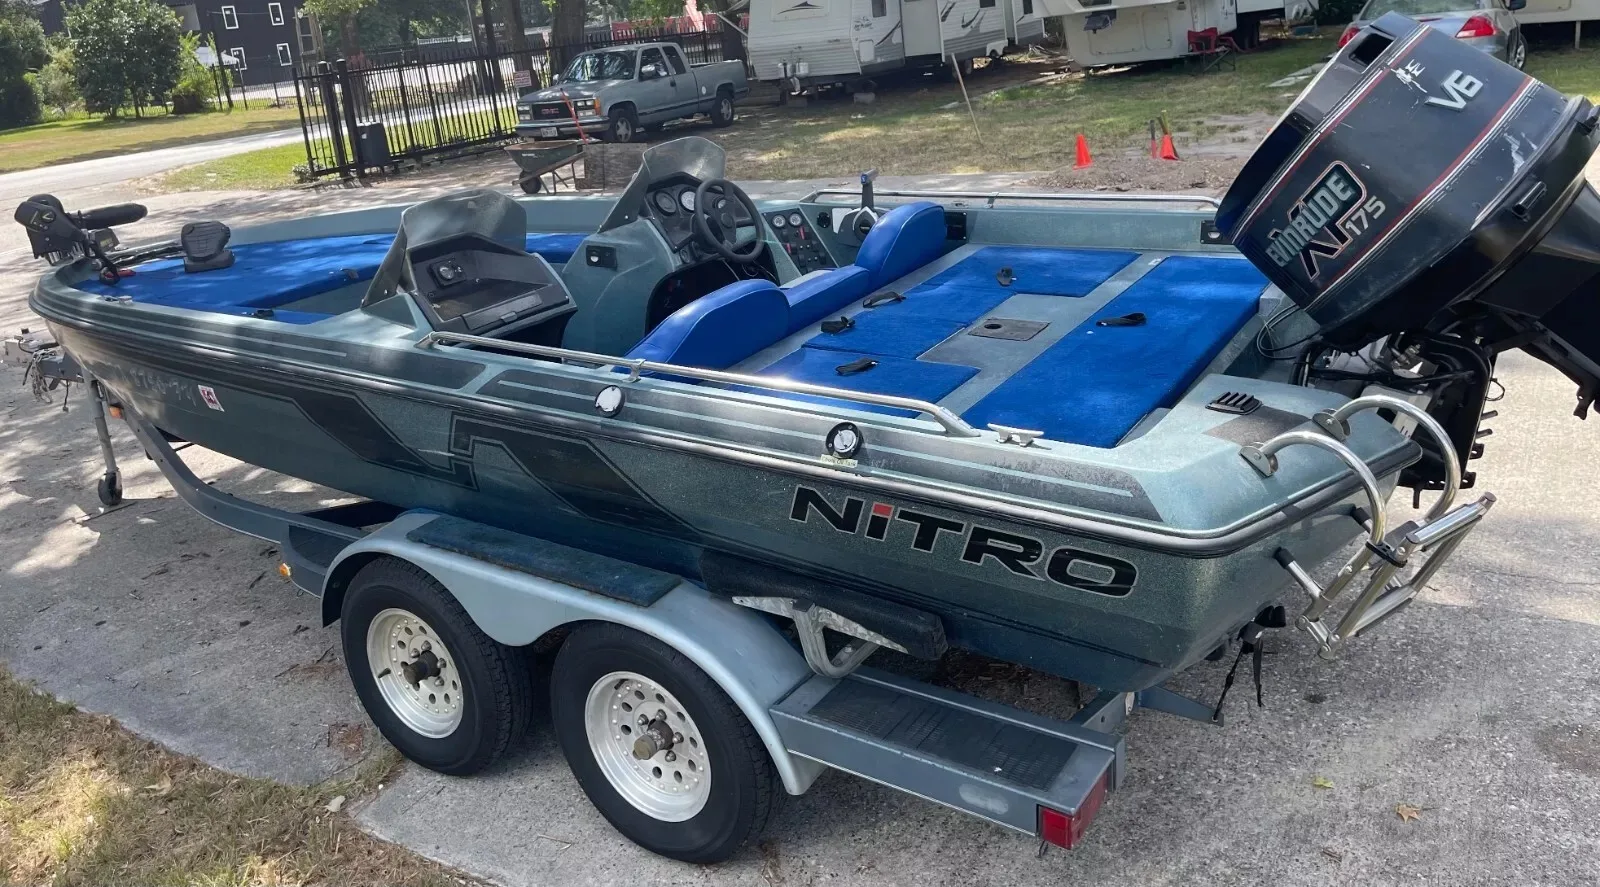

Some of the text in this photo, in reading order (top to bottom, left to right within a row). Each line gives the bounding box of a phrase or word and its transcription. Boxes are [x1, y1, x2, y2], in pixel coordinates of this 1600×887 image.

[1424, 69, 1484, 112] V6
[1265, 172, 1357, 268] EVINRUDE
[1345, 195, 1386, 236] 175
